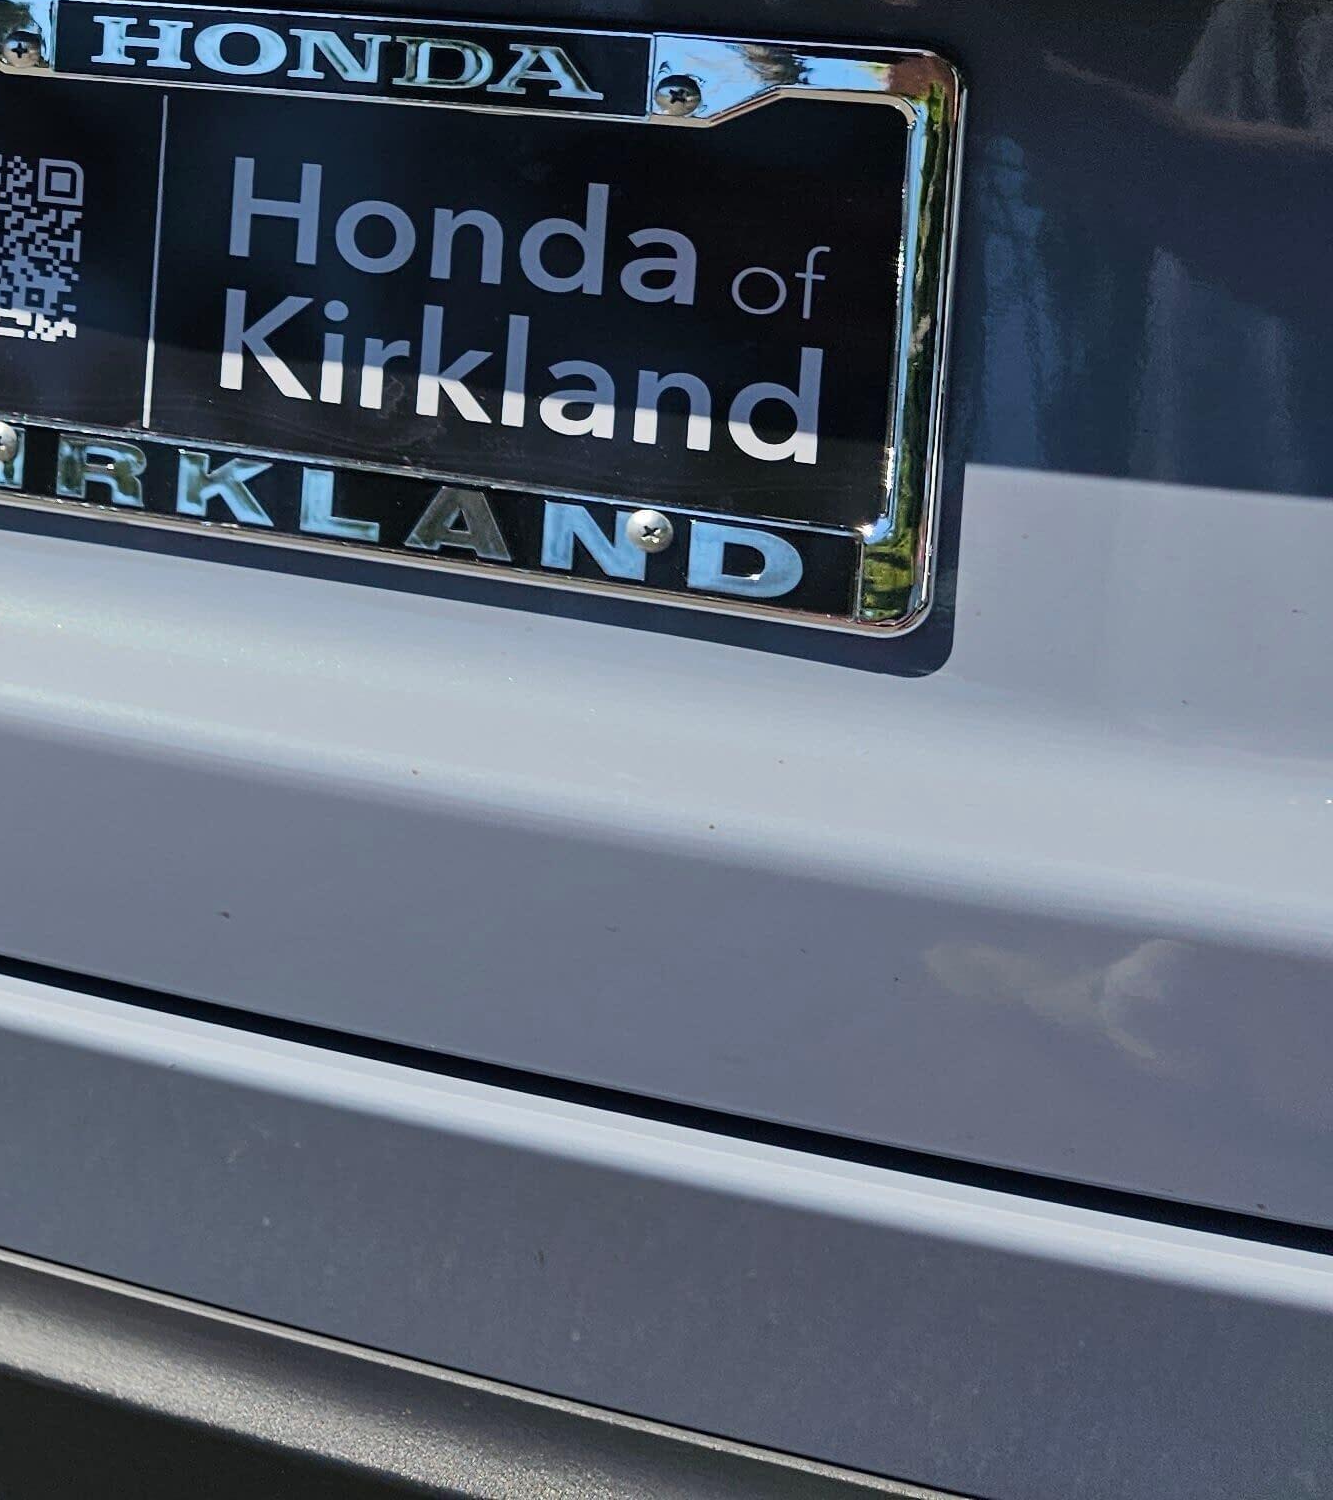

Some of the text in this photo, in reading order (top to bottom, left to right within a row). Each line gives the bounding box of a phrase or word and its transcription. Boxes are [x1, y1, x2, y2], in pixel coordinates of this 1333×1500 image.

[90, 15, 603, 102] HONDA
[228, 156, 829, 322] Honda of
[218, 288, 826, 466] Kirkland
